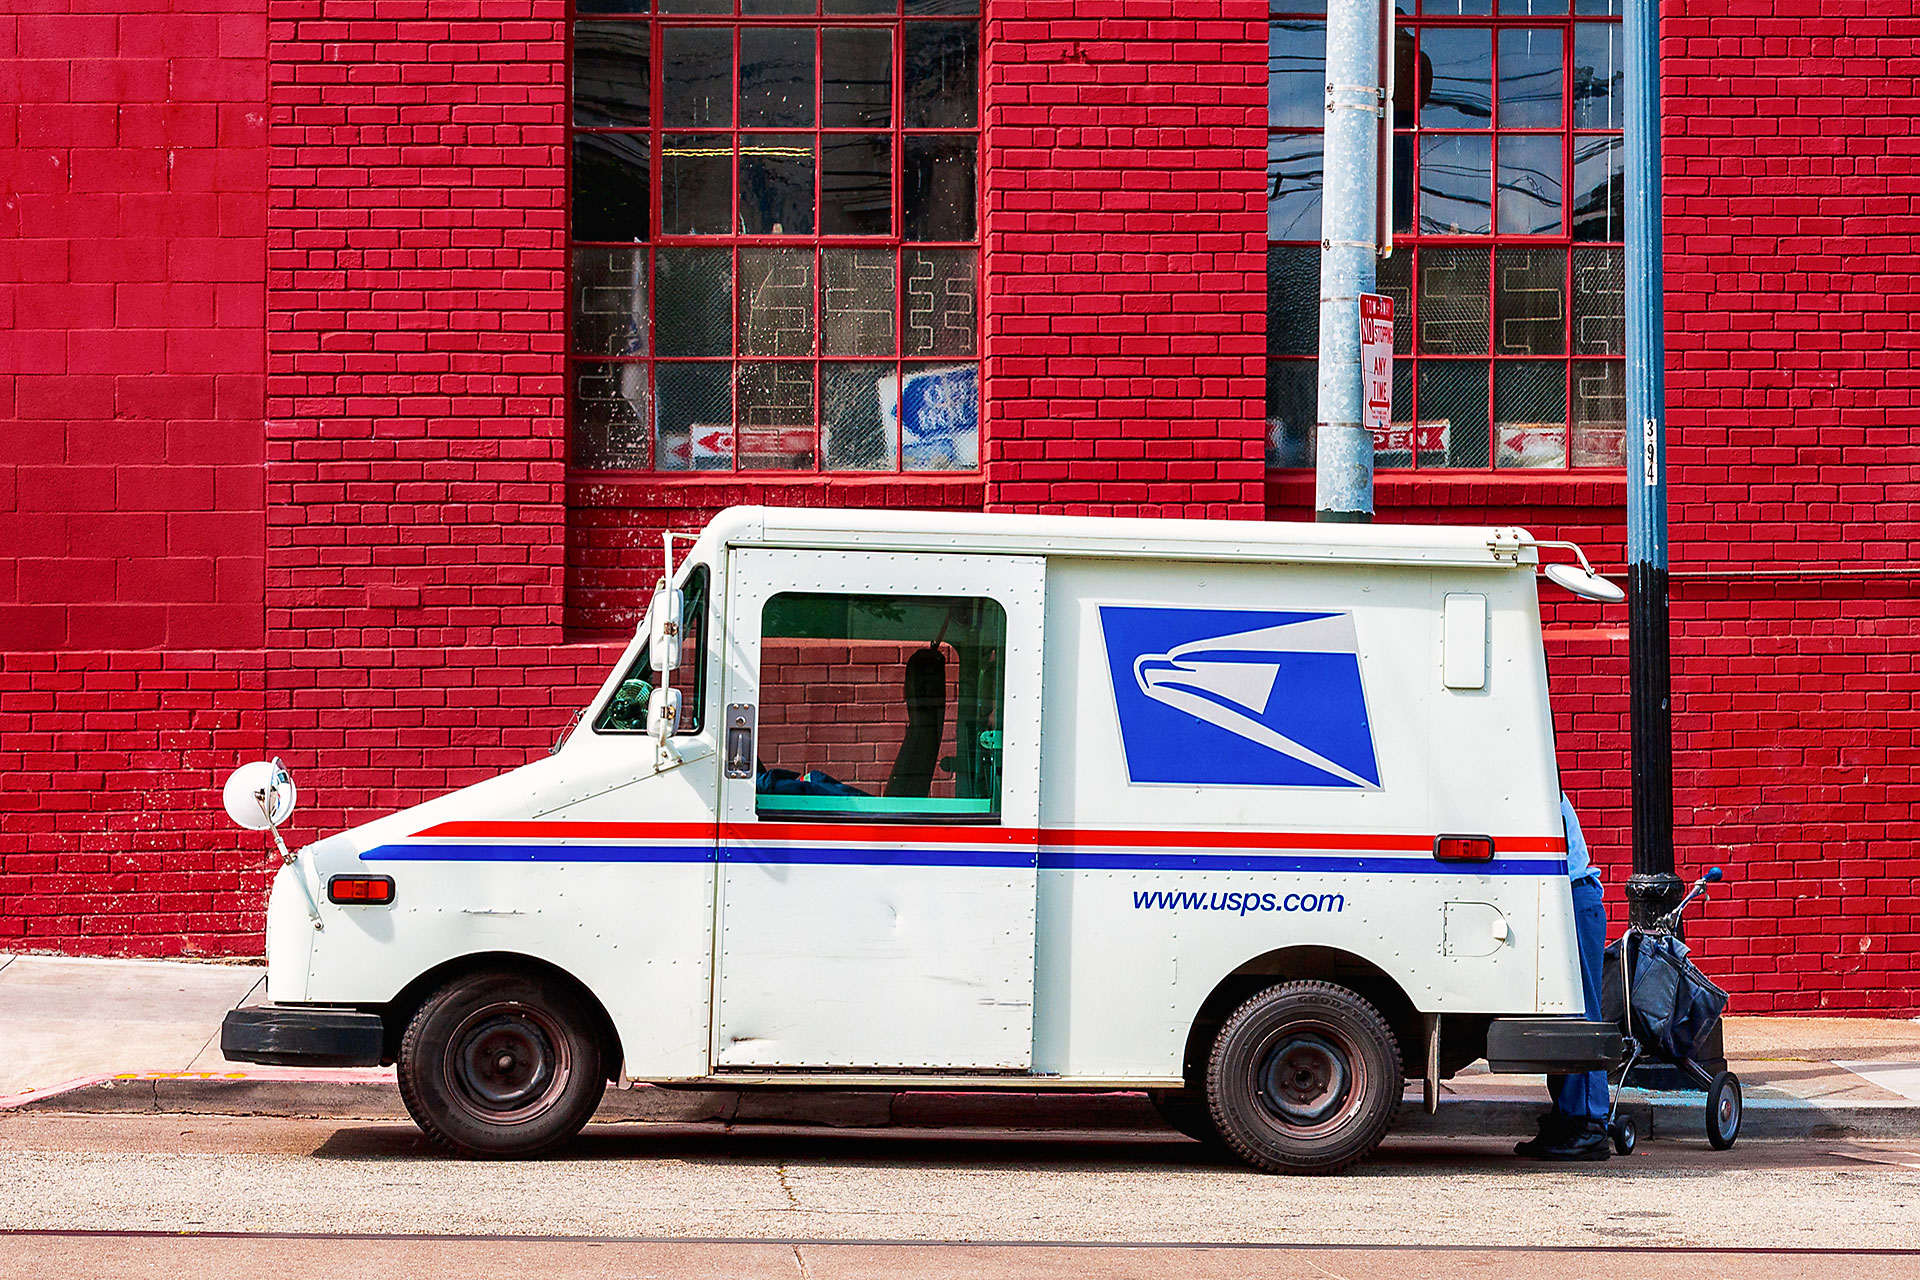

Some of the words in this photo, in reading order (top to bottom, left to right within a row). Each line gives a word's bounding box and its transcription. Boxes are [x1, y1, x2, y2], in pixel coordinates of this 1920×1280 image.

[1361, 317, 1373, 342] NO
[1374, 325, 1393, 345] STOPPING
[1373, 356, 1387, 376] ANY
[1373, 380, 1387, 401] TIME
[1373, 432, 1428, 448] PEN
[1133, 890, 1345, 917] www.usps.com
